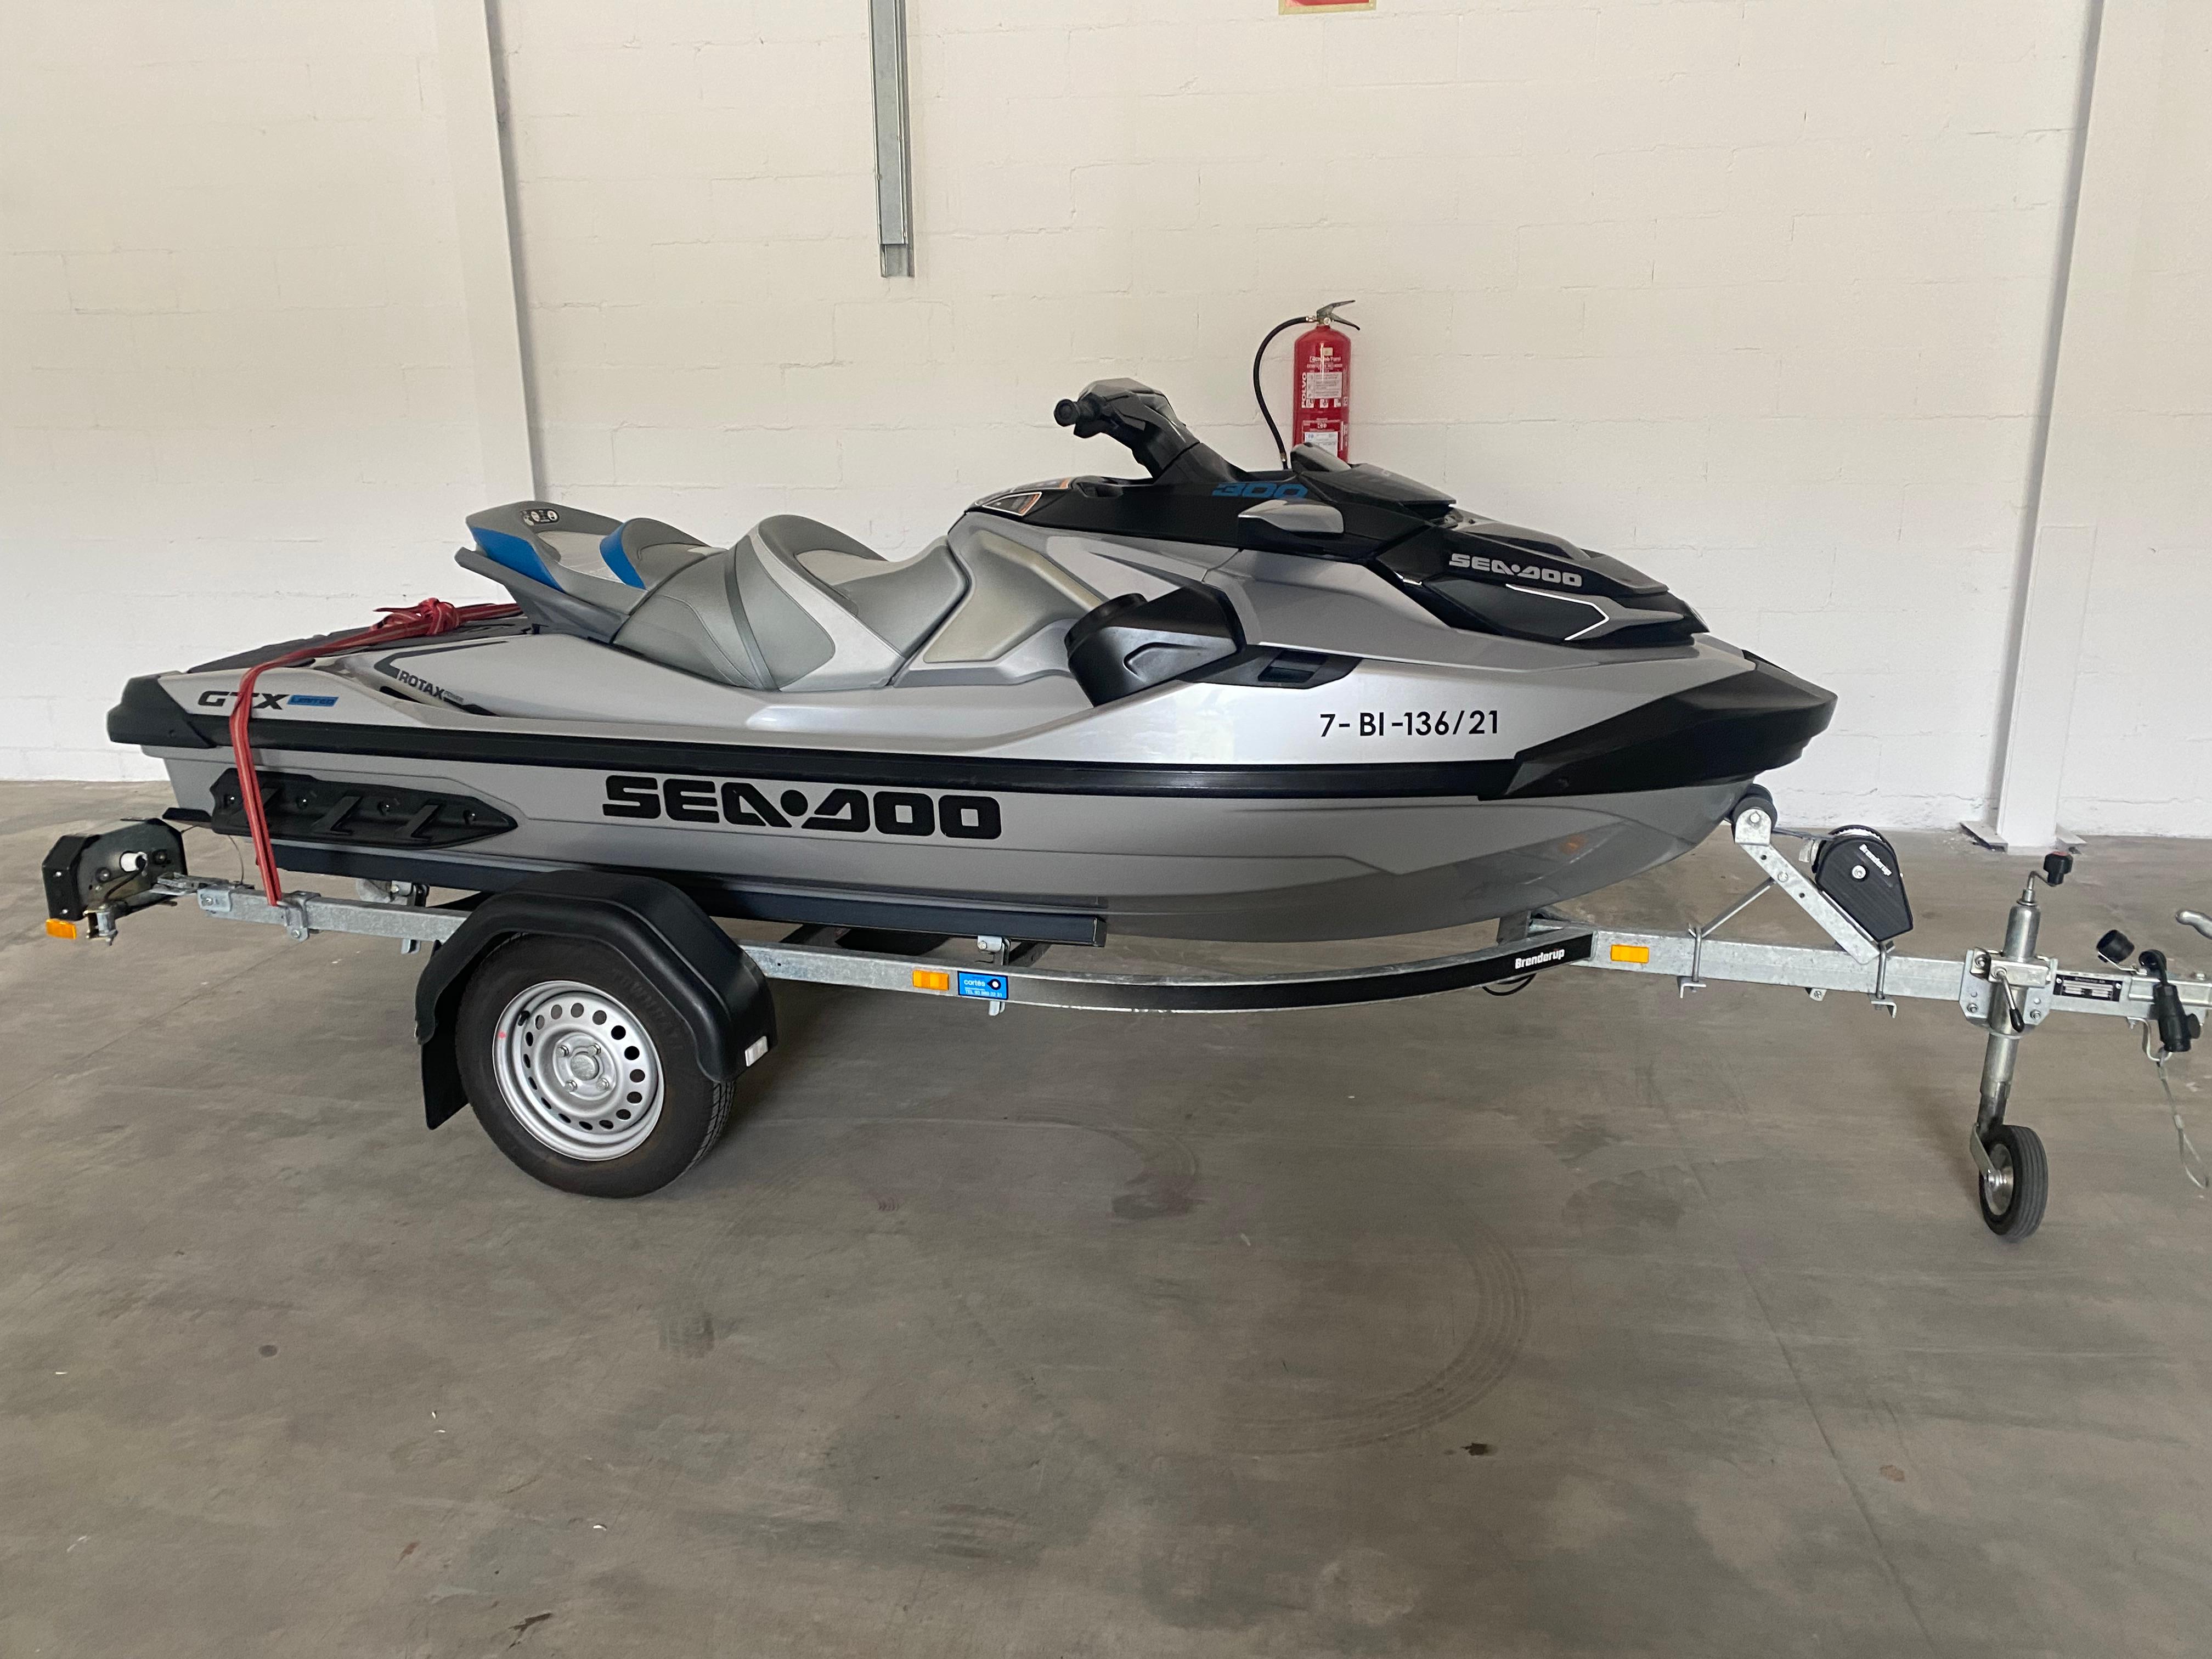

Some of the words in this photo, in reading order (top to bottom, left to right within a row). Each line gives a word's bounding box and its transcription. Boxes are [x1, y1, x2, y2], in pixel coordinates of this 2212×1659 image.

[1211, 482, 1308, 498] 300
[399, 670, 445, 700] ROTAX
[1515, 949, 1565, 969] Brenderup
